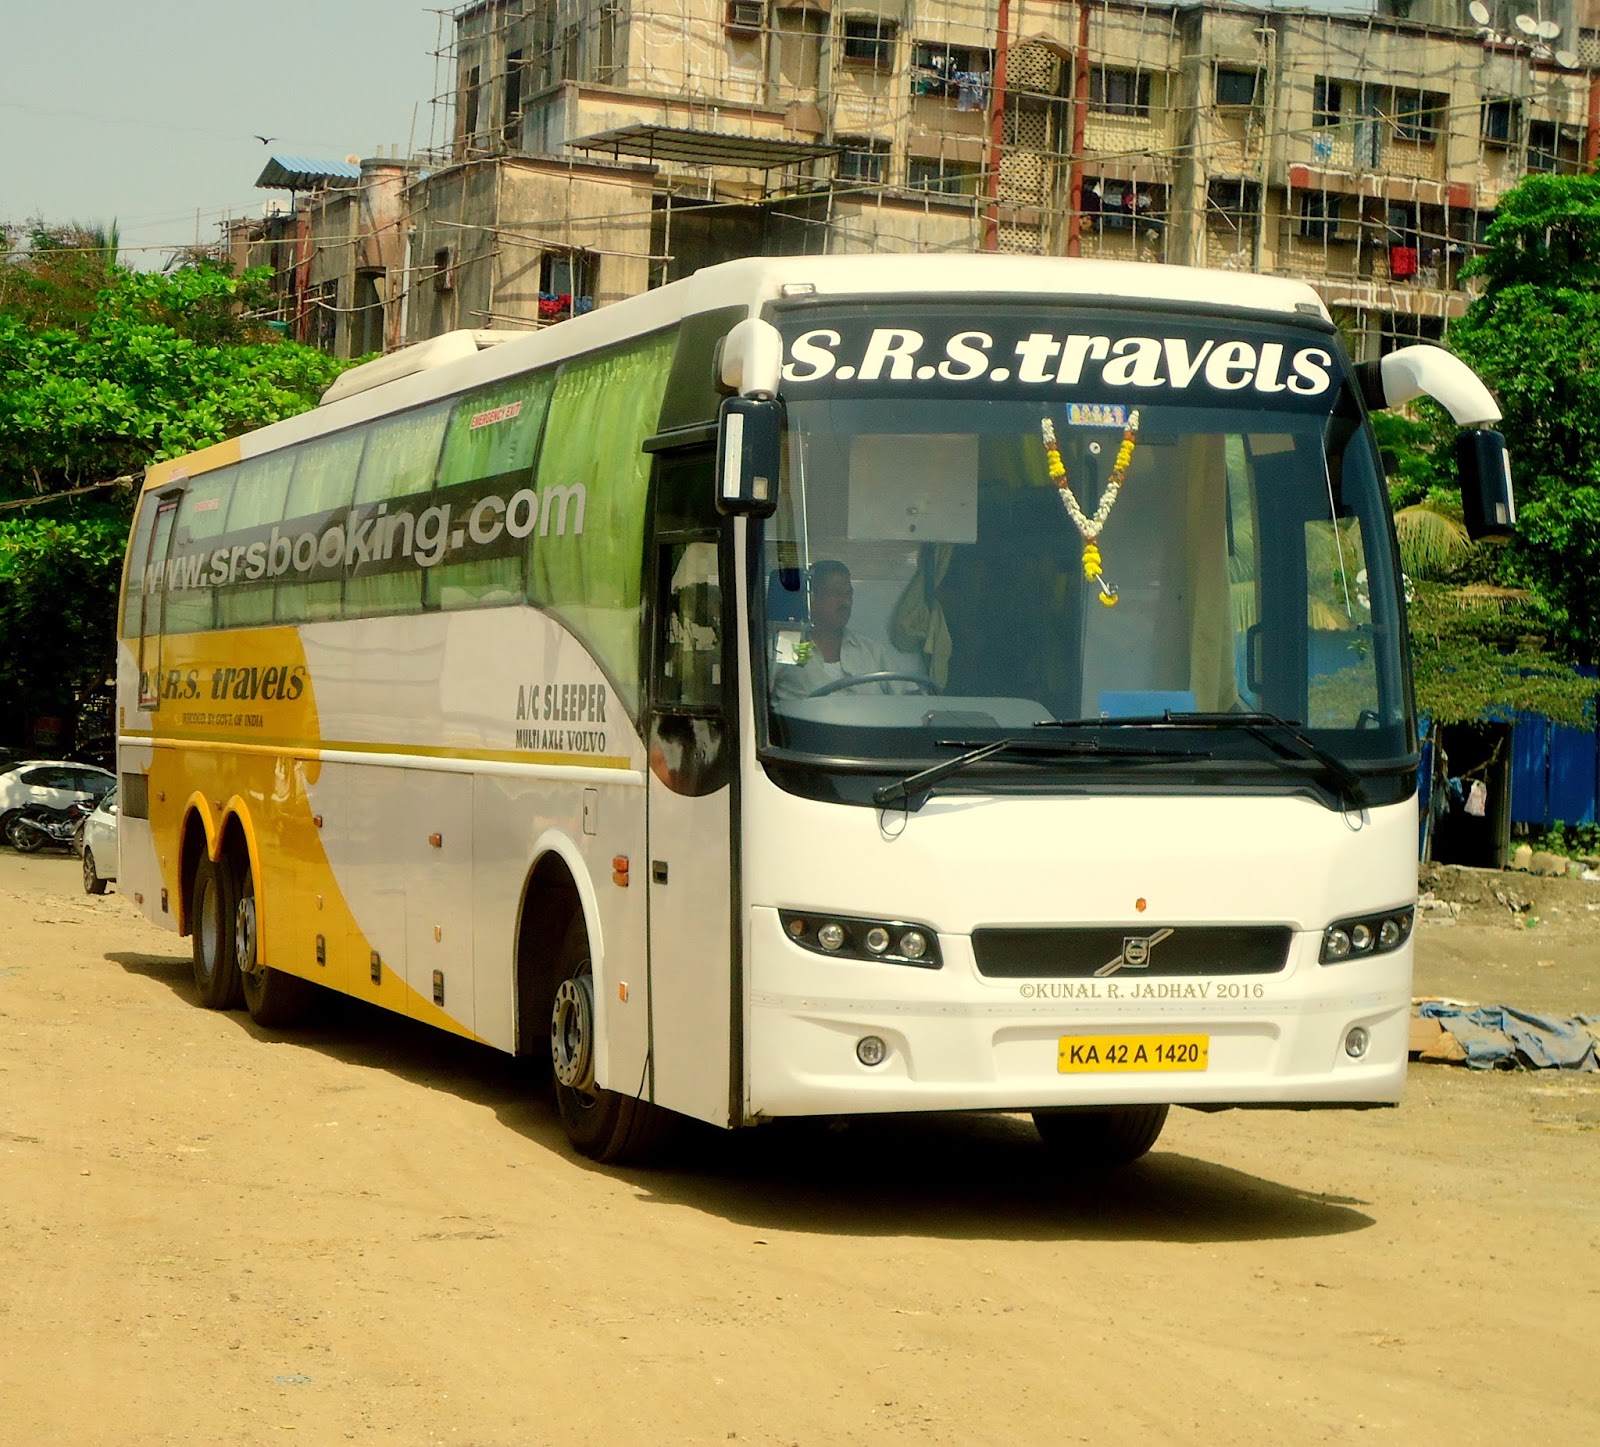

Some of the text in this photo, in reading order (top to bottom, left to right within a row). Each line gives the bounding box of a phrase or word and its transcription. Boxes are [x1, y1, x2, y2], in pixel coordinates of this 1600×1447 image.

[505, 402, 520, 418] EXIT
[141, 482, 587, 595] www.srsbooking.com
[211, 665, 306, 701] travels
[516, 684, 606, 722] A/C SLEEPER
[234, 714, 243, 727] OF
[244, 714, 263, 727] INDIA
[516, 729, 606, 753] MULTI AXLE VOLVO
[1070, 1043, 1199, 1064] KA 42 A 1420
